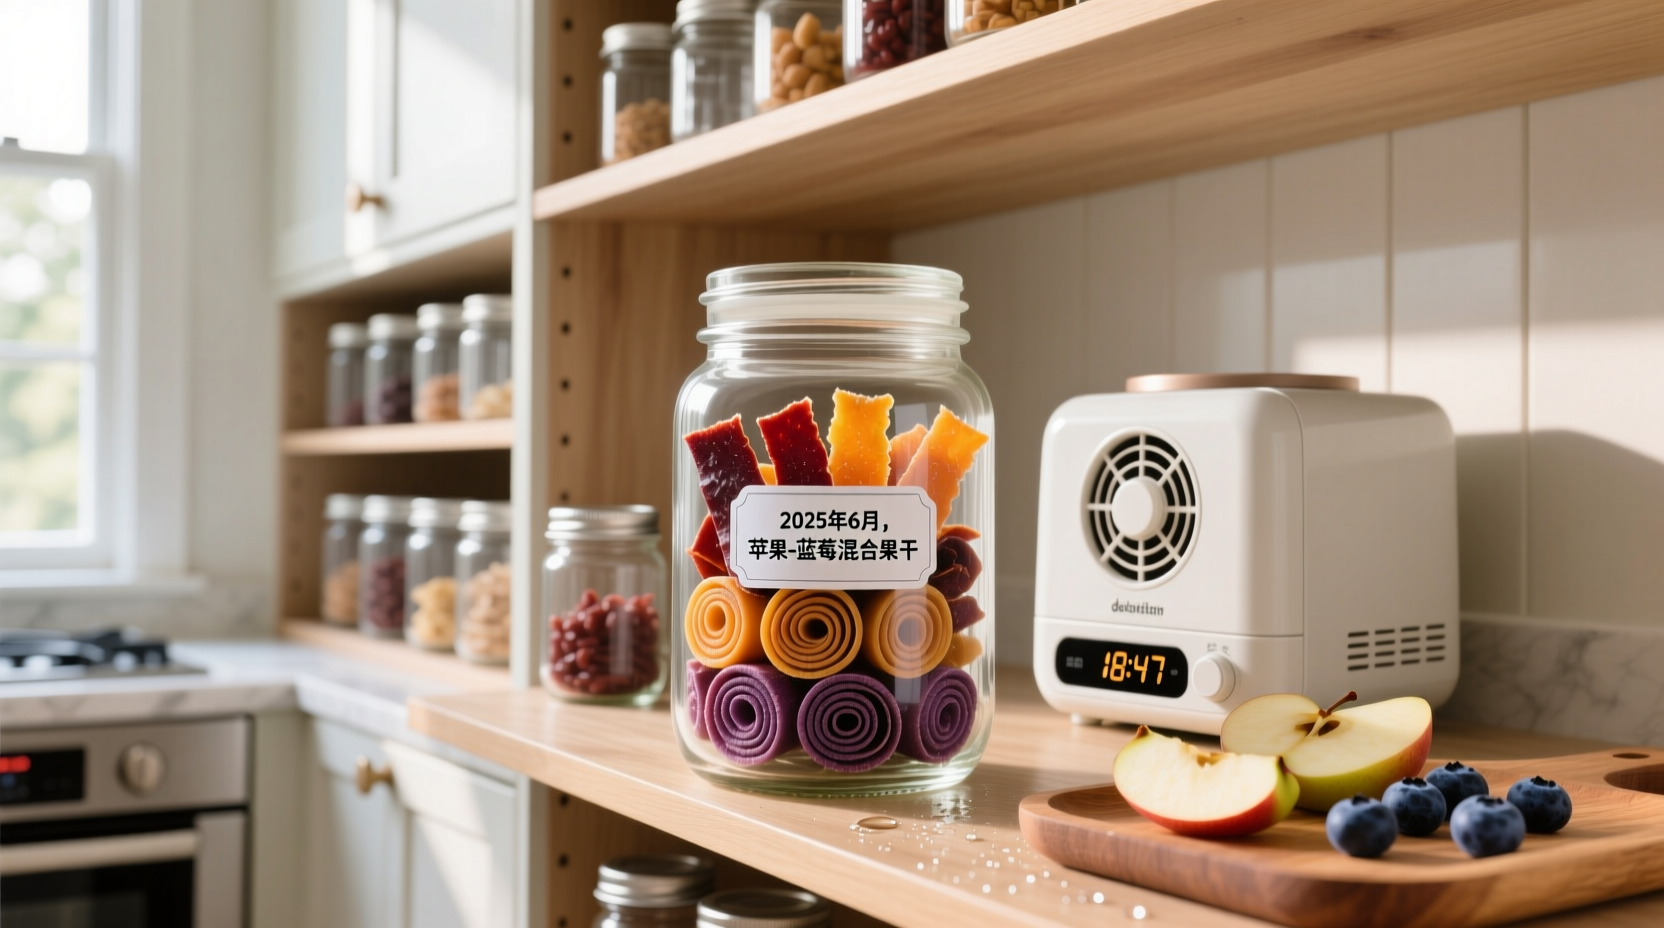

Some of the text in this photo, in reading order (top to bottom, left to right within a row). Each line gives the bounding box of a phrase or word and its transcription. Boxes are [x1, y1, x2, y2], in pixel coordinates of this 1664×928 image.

[748, 537, 918, 561] 苹果-蓝莓混合果干
[1102, 651, 1166, 685] 18:47
